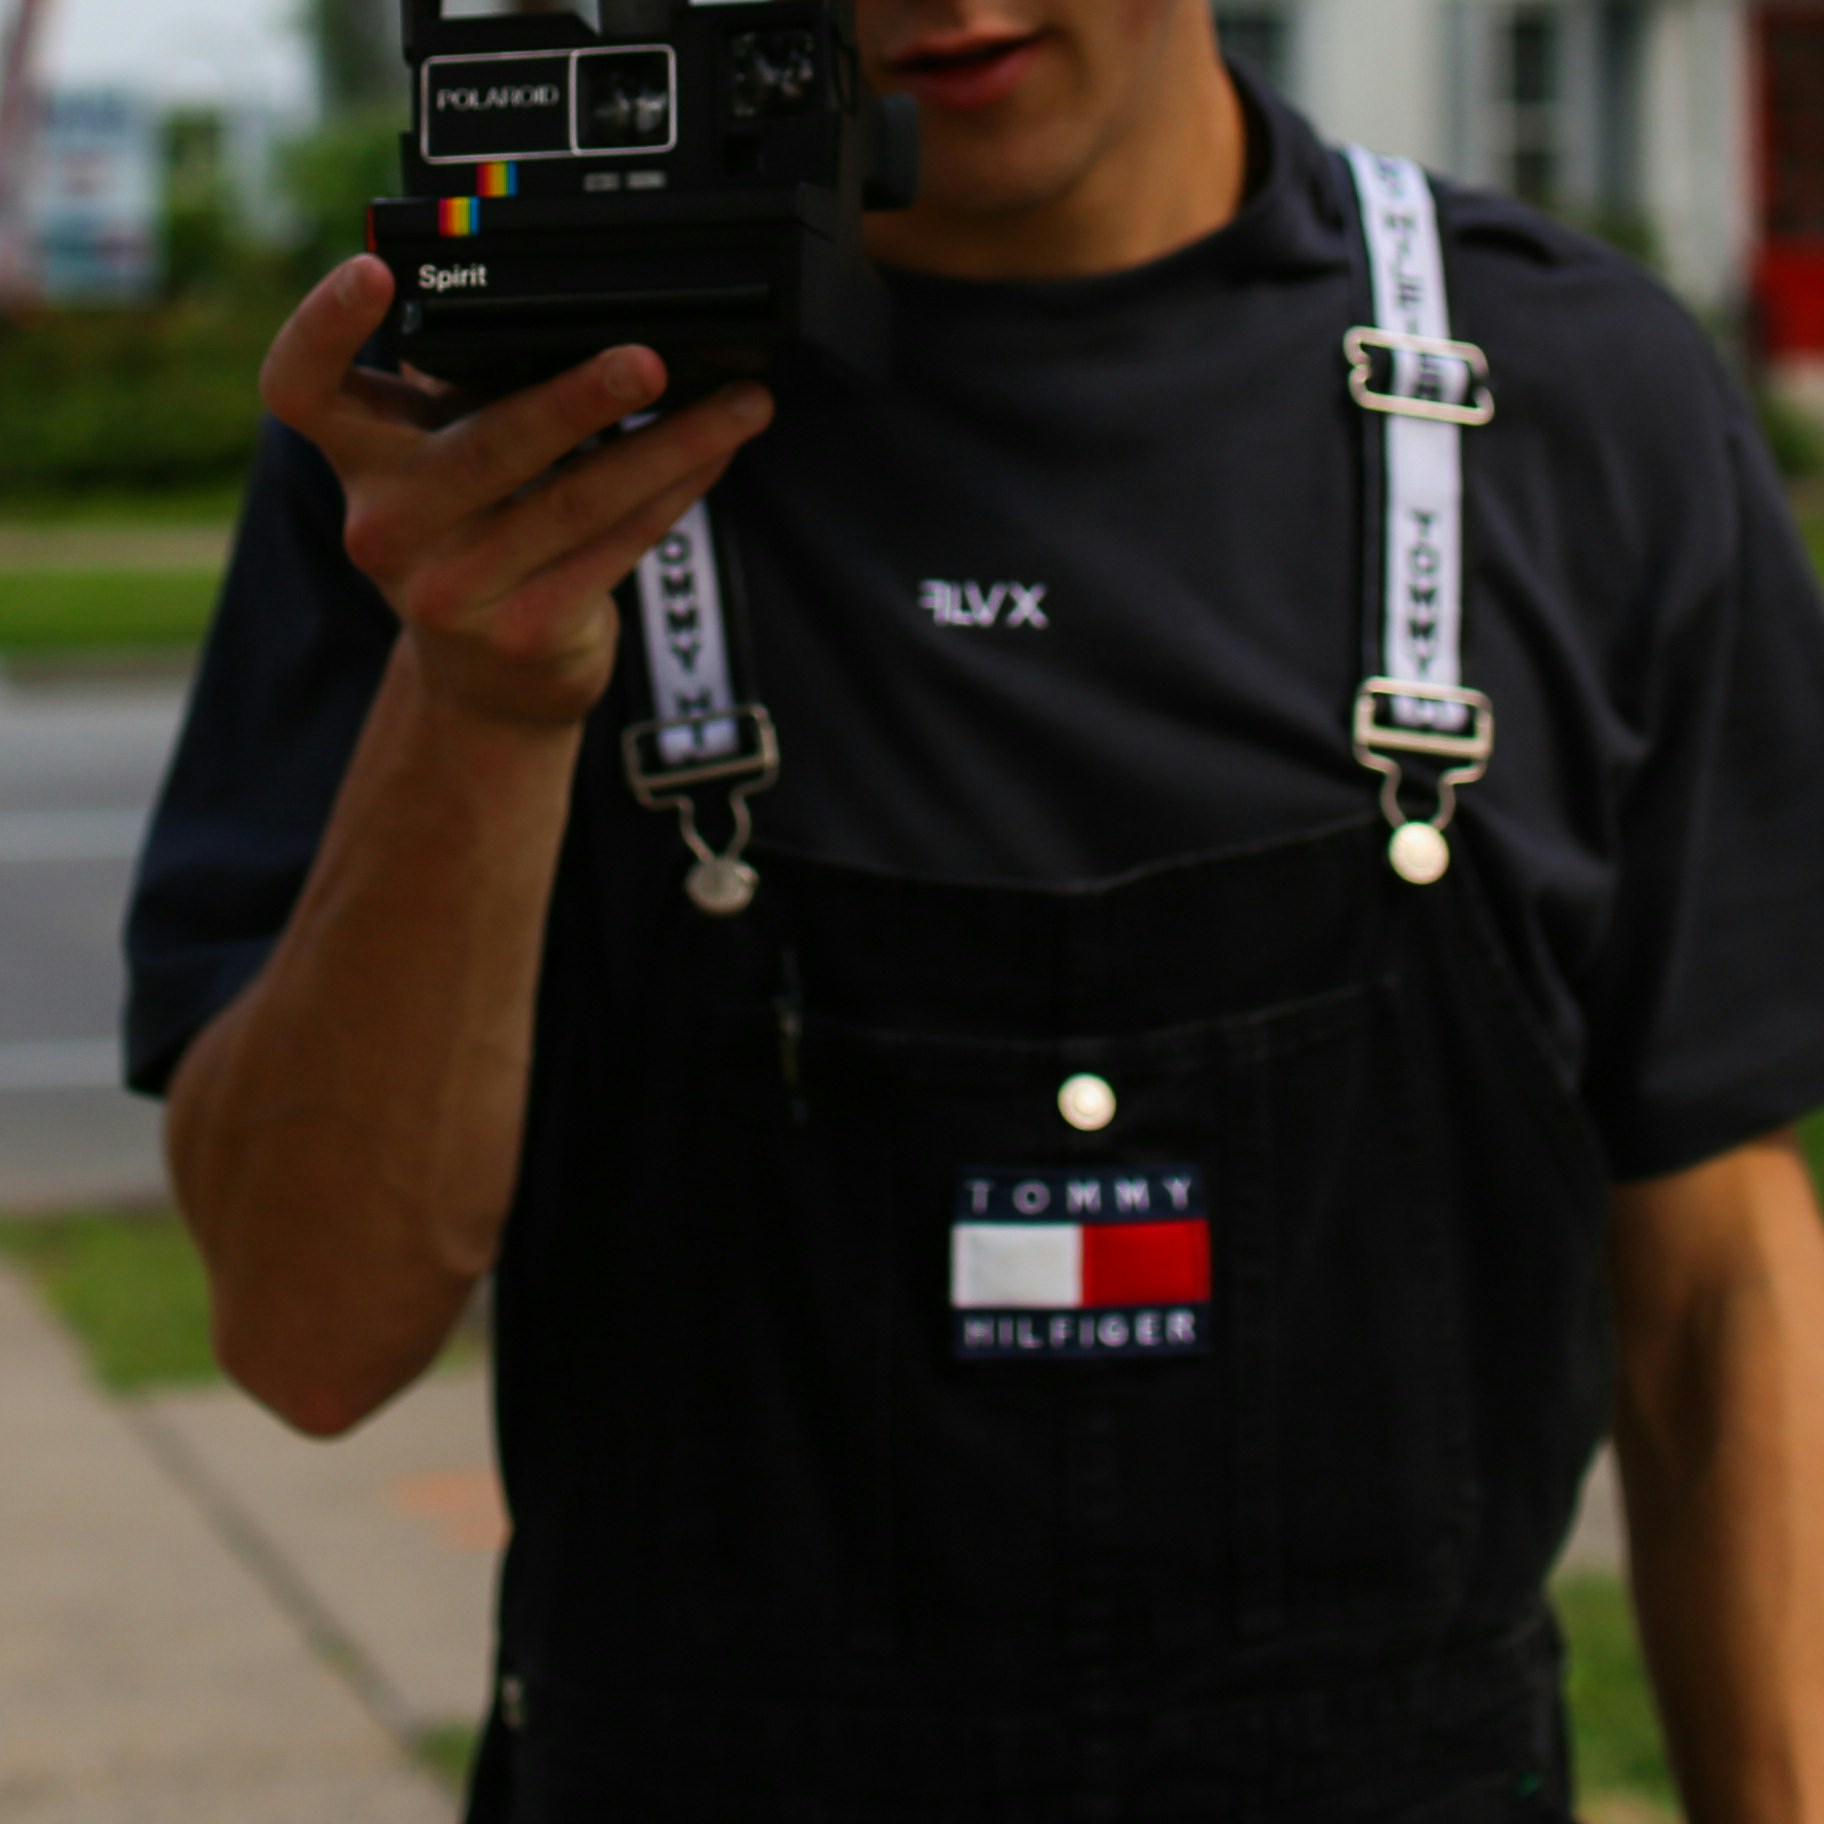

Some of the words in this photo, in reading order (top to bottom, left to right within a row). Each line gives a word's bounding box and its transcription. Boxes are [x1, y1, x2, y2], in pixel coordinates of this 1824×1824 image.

[435, 85, 560, 112] POLAROID
[418, 263, 488, 293] Spirit
[656, 531, 703, 675] OMMY
[964, 1176, 1192, 1216] TOMMY
[962, 1309, 1197, 1349] HILFIGER
